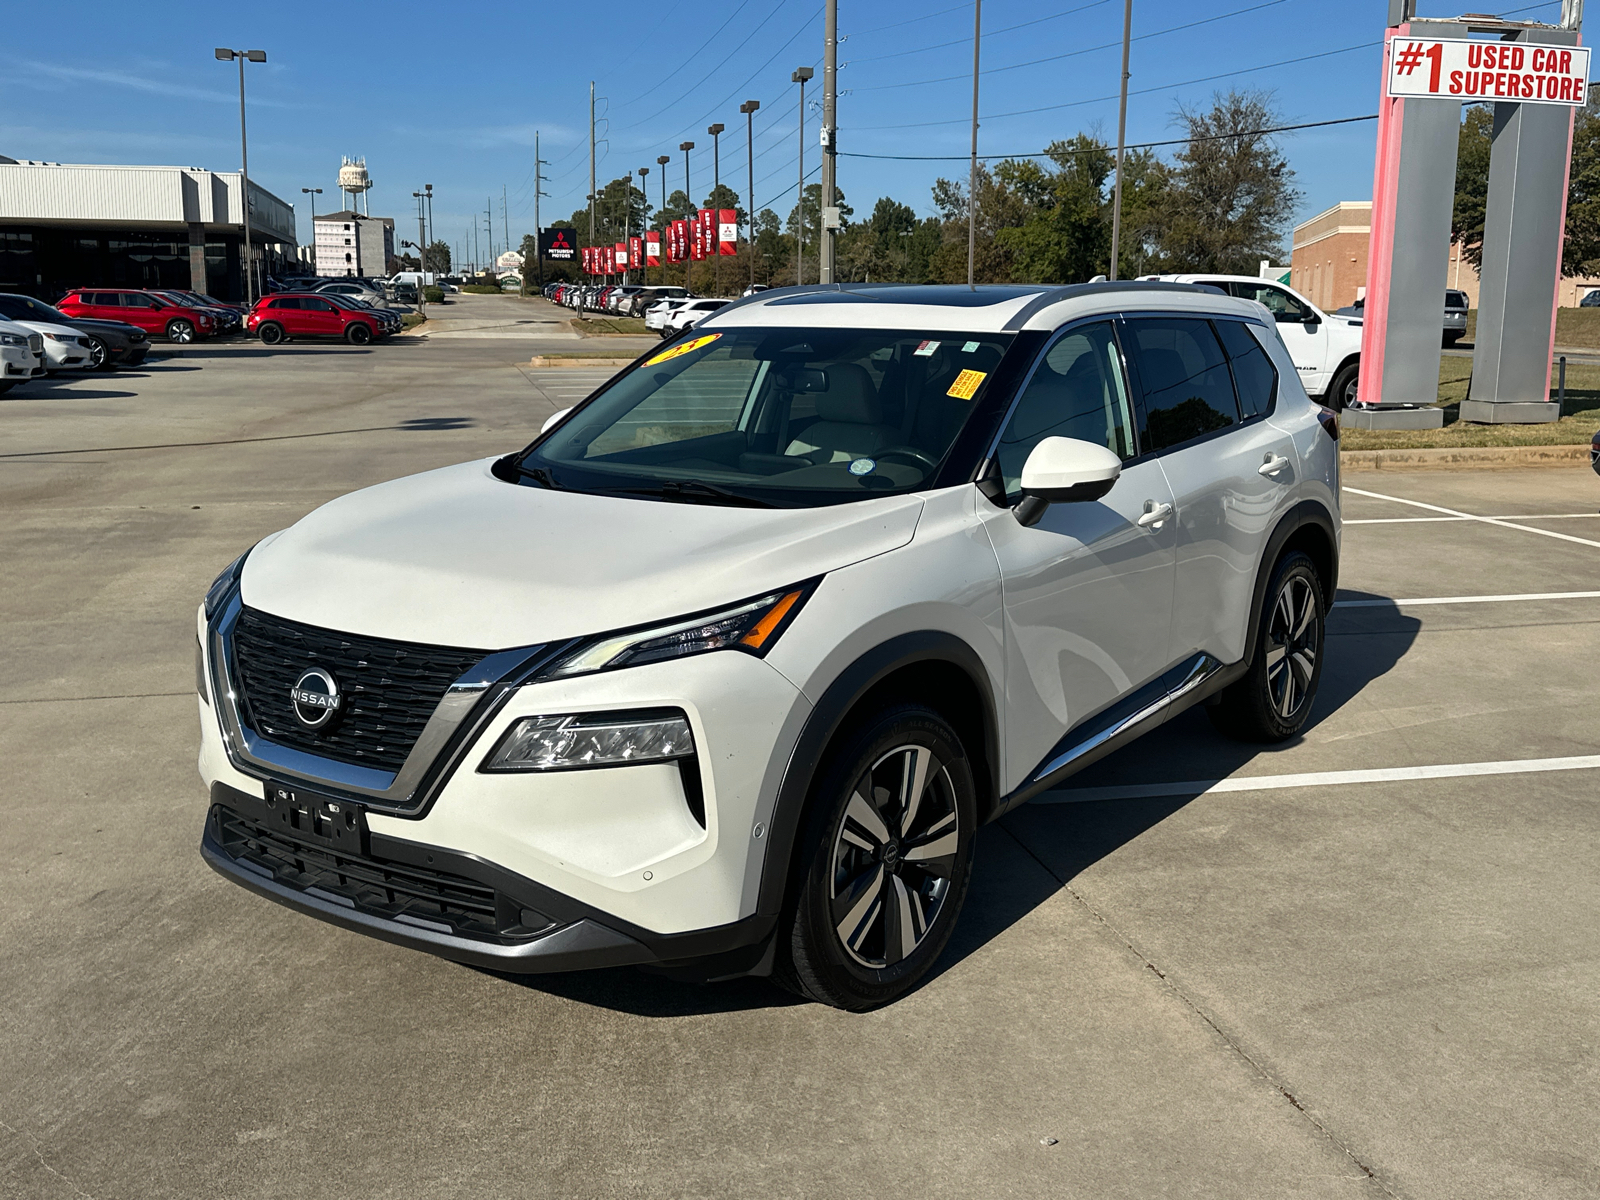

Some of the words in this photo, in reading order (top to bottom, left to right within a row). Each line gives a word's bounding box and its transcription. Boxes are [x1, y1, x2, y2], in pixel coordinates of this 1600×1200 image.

[1394, 42, 1443, 93] #1
[1468, 45, 1525, 71] USED
[1532, 48, 1572, 75] CAR
[1449, 70, 1584, 102] SUPERSTORE
[291, 689, 338, 708] NISSAN
